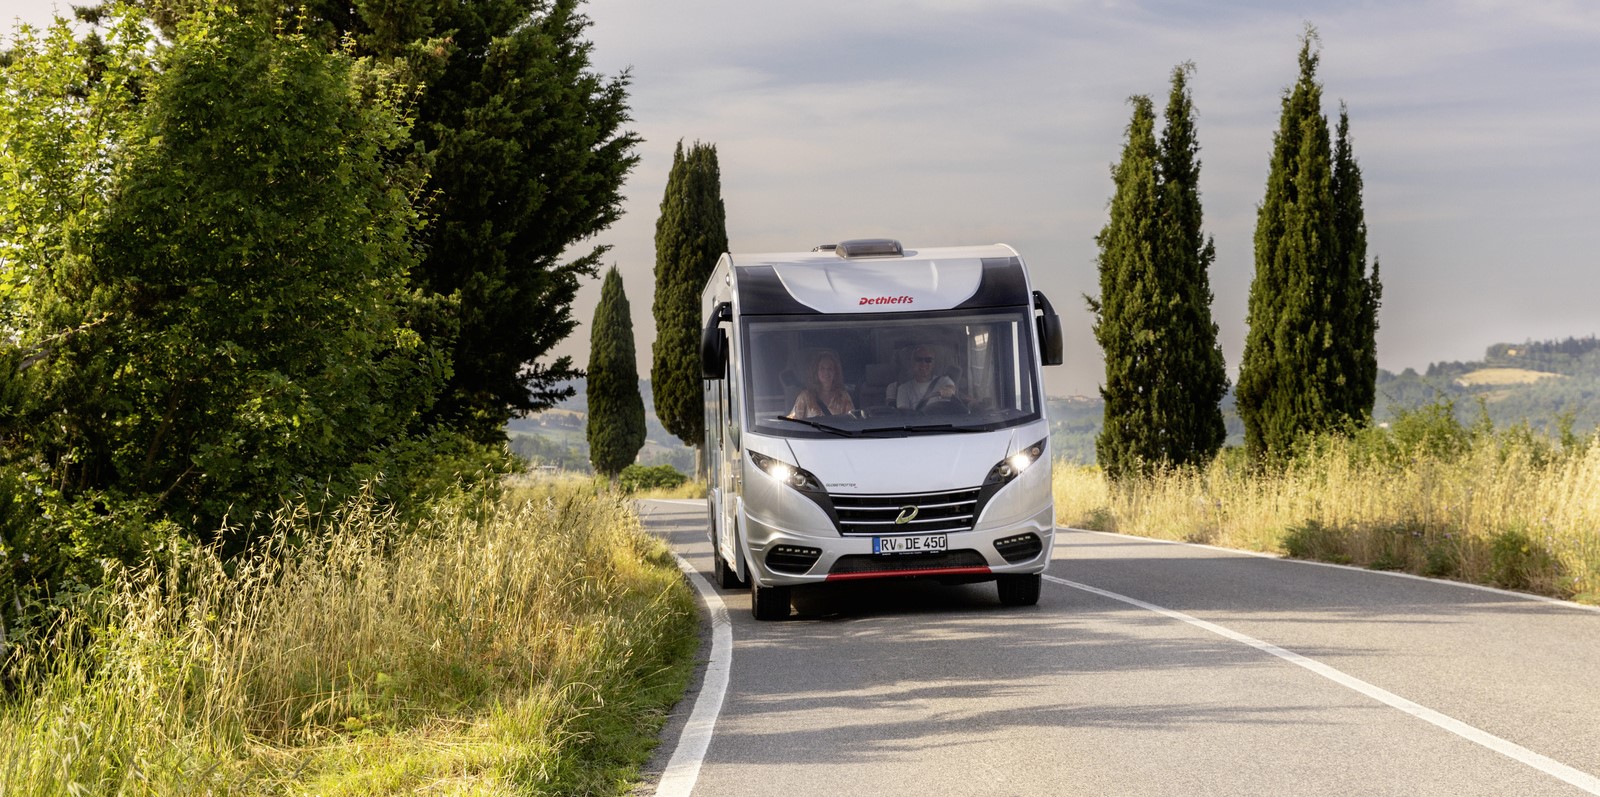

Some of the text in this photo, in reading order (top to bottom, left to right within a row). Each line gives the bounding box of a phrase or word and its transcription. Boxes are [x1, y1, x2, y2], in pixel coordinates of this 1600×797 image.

[859, 296, 914, 305] Dethleffs
[881, 536, 946, 551] RV DE 450
